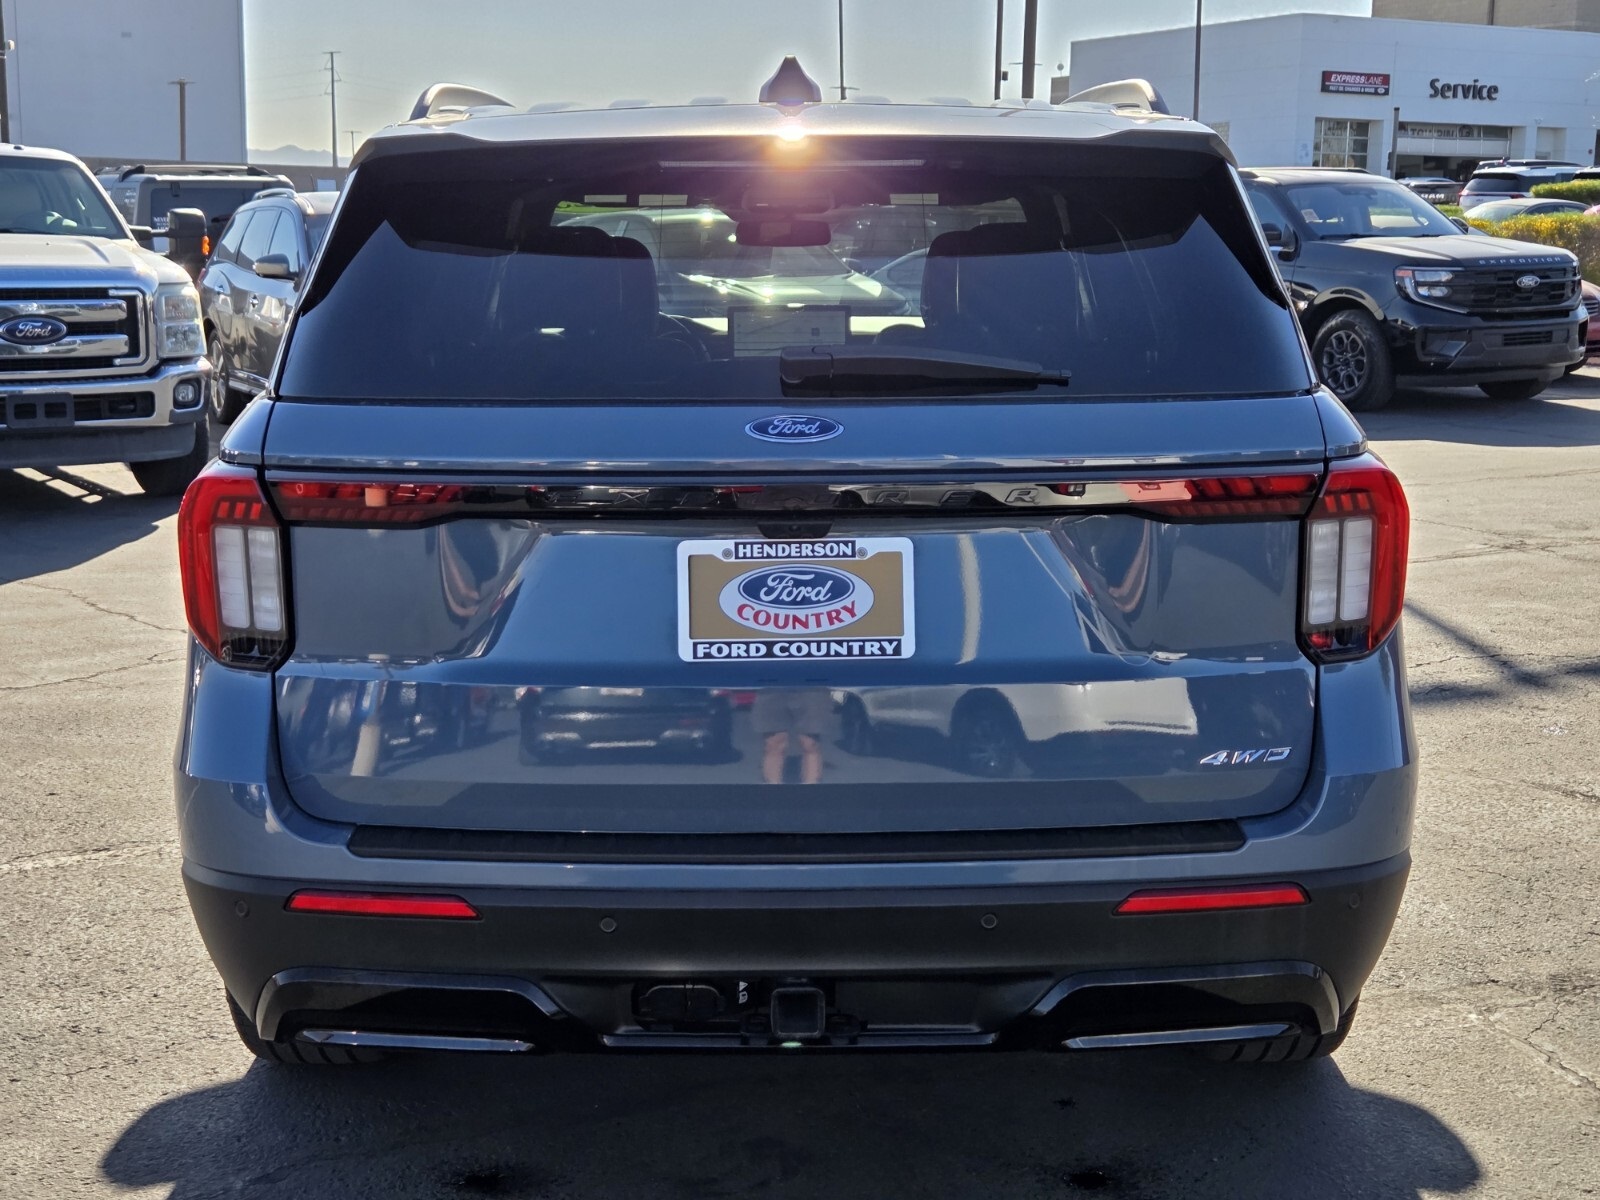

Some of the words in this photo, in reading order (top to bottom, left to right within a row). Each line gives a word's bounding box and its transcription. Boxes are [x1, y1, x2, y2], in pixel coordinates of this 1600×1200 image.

[1429, 78, 1499, 101] Service
[1479, 256, 1561, 265] EXPEDITION
[1519, 276, 1538, 287] Ford
[15, 321, 52, 338] Ford
[767, 414, 820, 436] Ford
[737, 542, 854, 559] HENDERSON
[759, 573, 832, 604] Ford
[737, 600, 858, 631] COUNTRY
[696, 642, 767, 658] FORD
[773, 640, 899, 657] COUNTRY
[1199, 747, 1293, 766] 4WD
